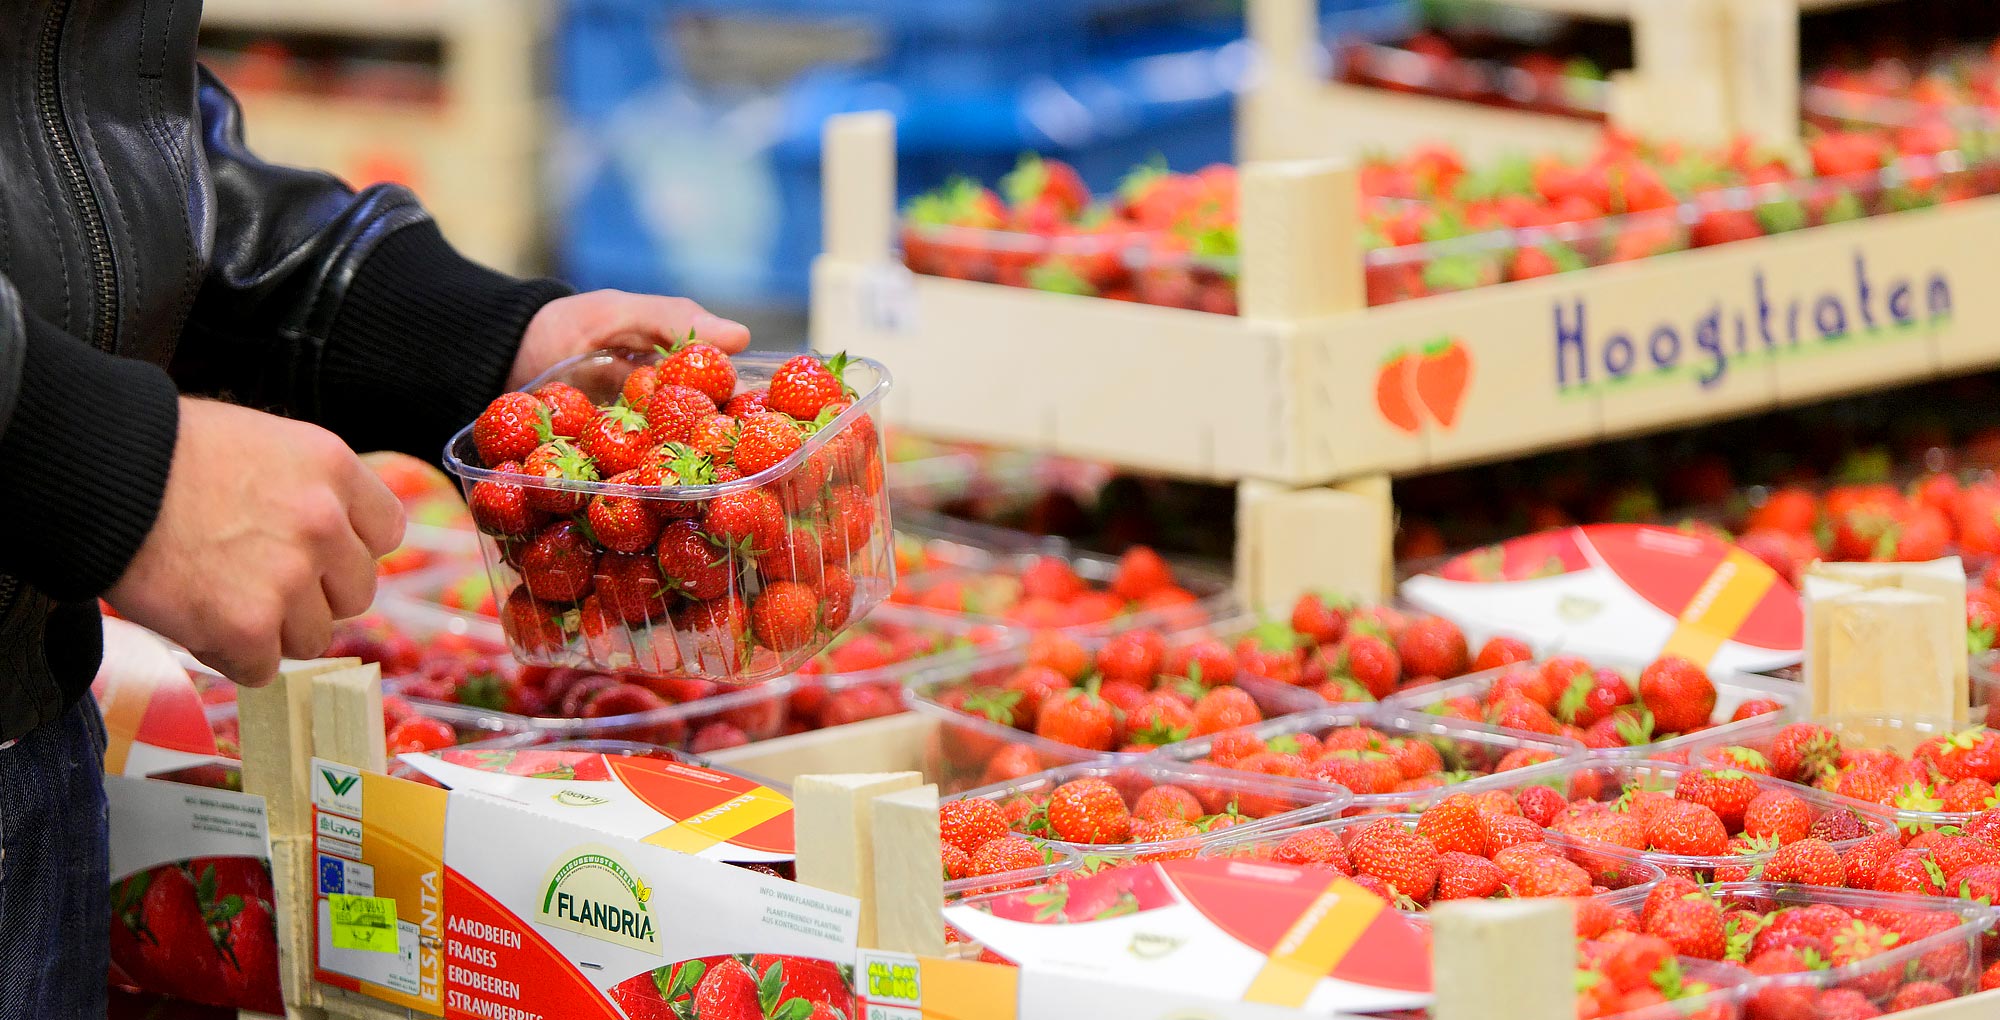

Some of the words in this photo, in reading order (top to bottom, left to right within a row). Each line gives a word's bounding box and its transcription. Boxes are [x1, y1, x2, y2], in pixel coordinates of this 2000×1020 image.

[688, 794, 756, 824] ELSANTA
[555, 855, 614, 883] MILIEUBEWUSTE
[615, 864, 636, 889] TEELT
[448, 915, 521, 950] AARDBEIEN
[558, 892, 655, 943] FLANDRIA
[420, 870, 438, 1002] ELSANTA
[448, 939, 497, 968] FRAISES
[448, 965, 520, 1000] ERDBEEREN
[868, 962, 890, 977] ALL
[892, 963, 918, 980] DAY
[869, 975, 918, 1001] LONG
[448, 990, 544, 1020] STRAWBERRI
